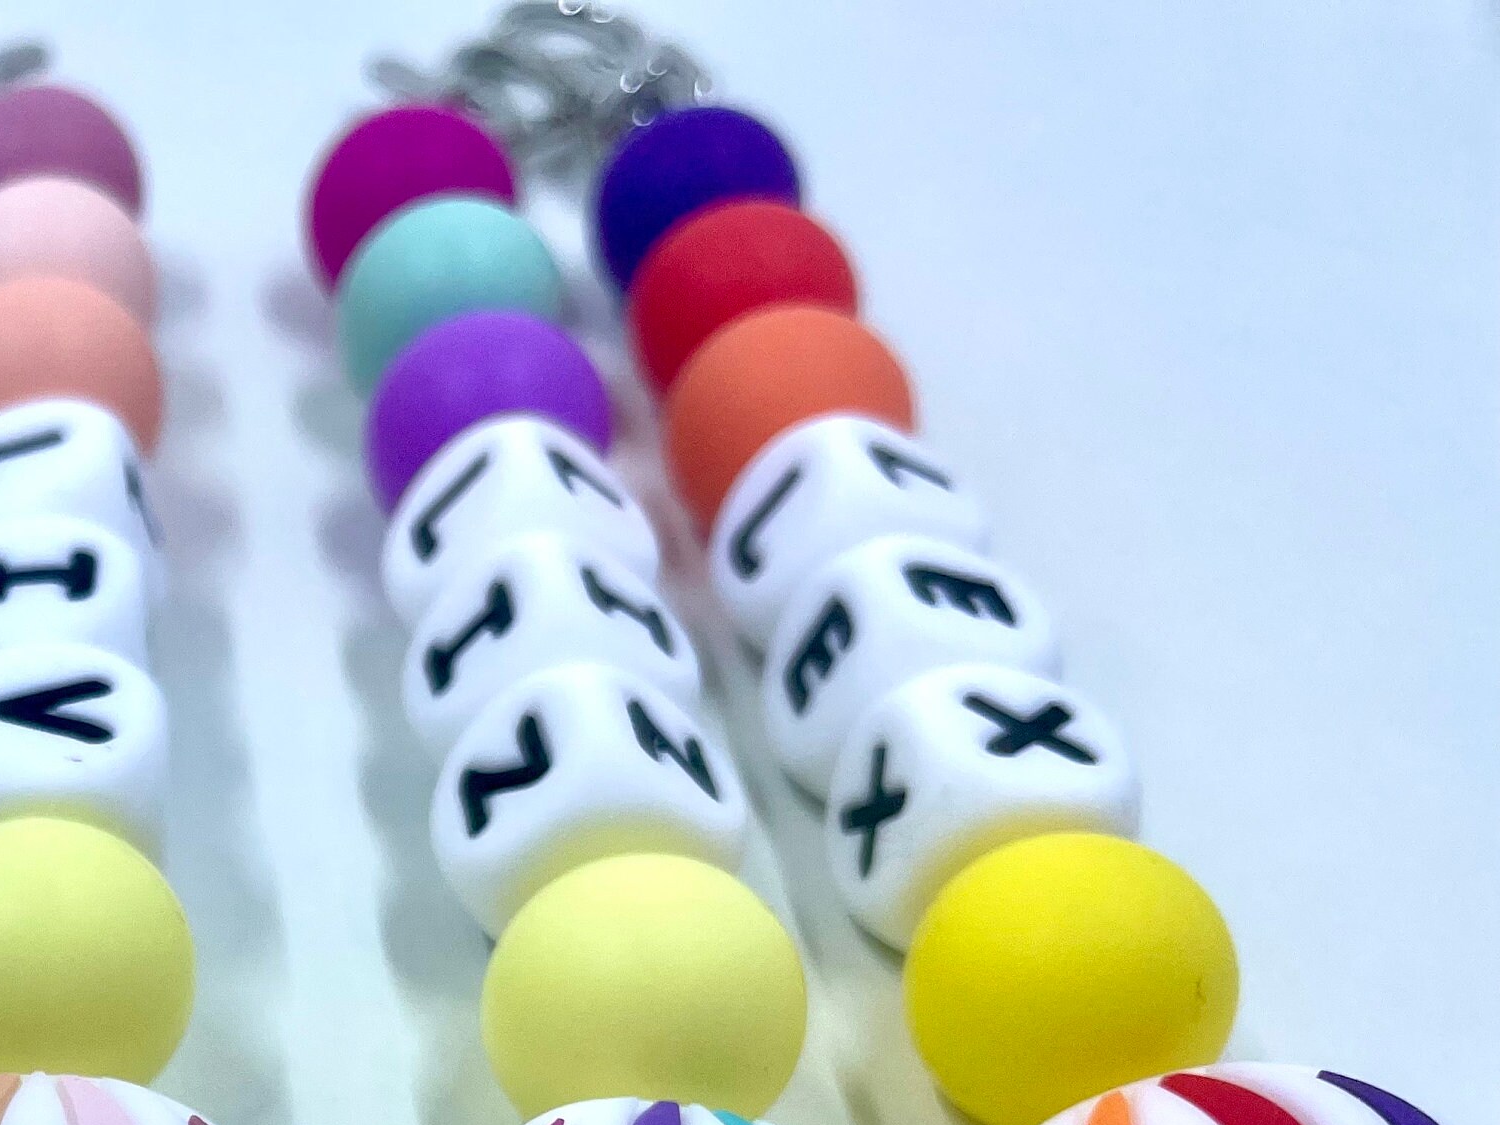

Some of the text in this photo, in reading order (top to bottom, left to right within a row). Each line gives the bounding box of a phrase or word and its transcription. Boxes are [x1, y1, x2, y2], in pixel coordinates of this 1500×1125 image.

[411, 453, 552, 838] LIZ
[547, 448, 722, 802] LIZ
[729, 462, 907, 880] LEX
[867, 441, 1100, 766] LEX
